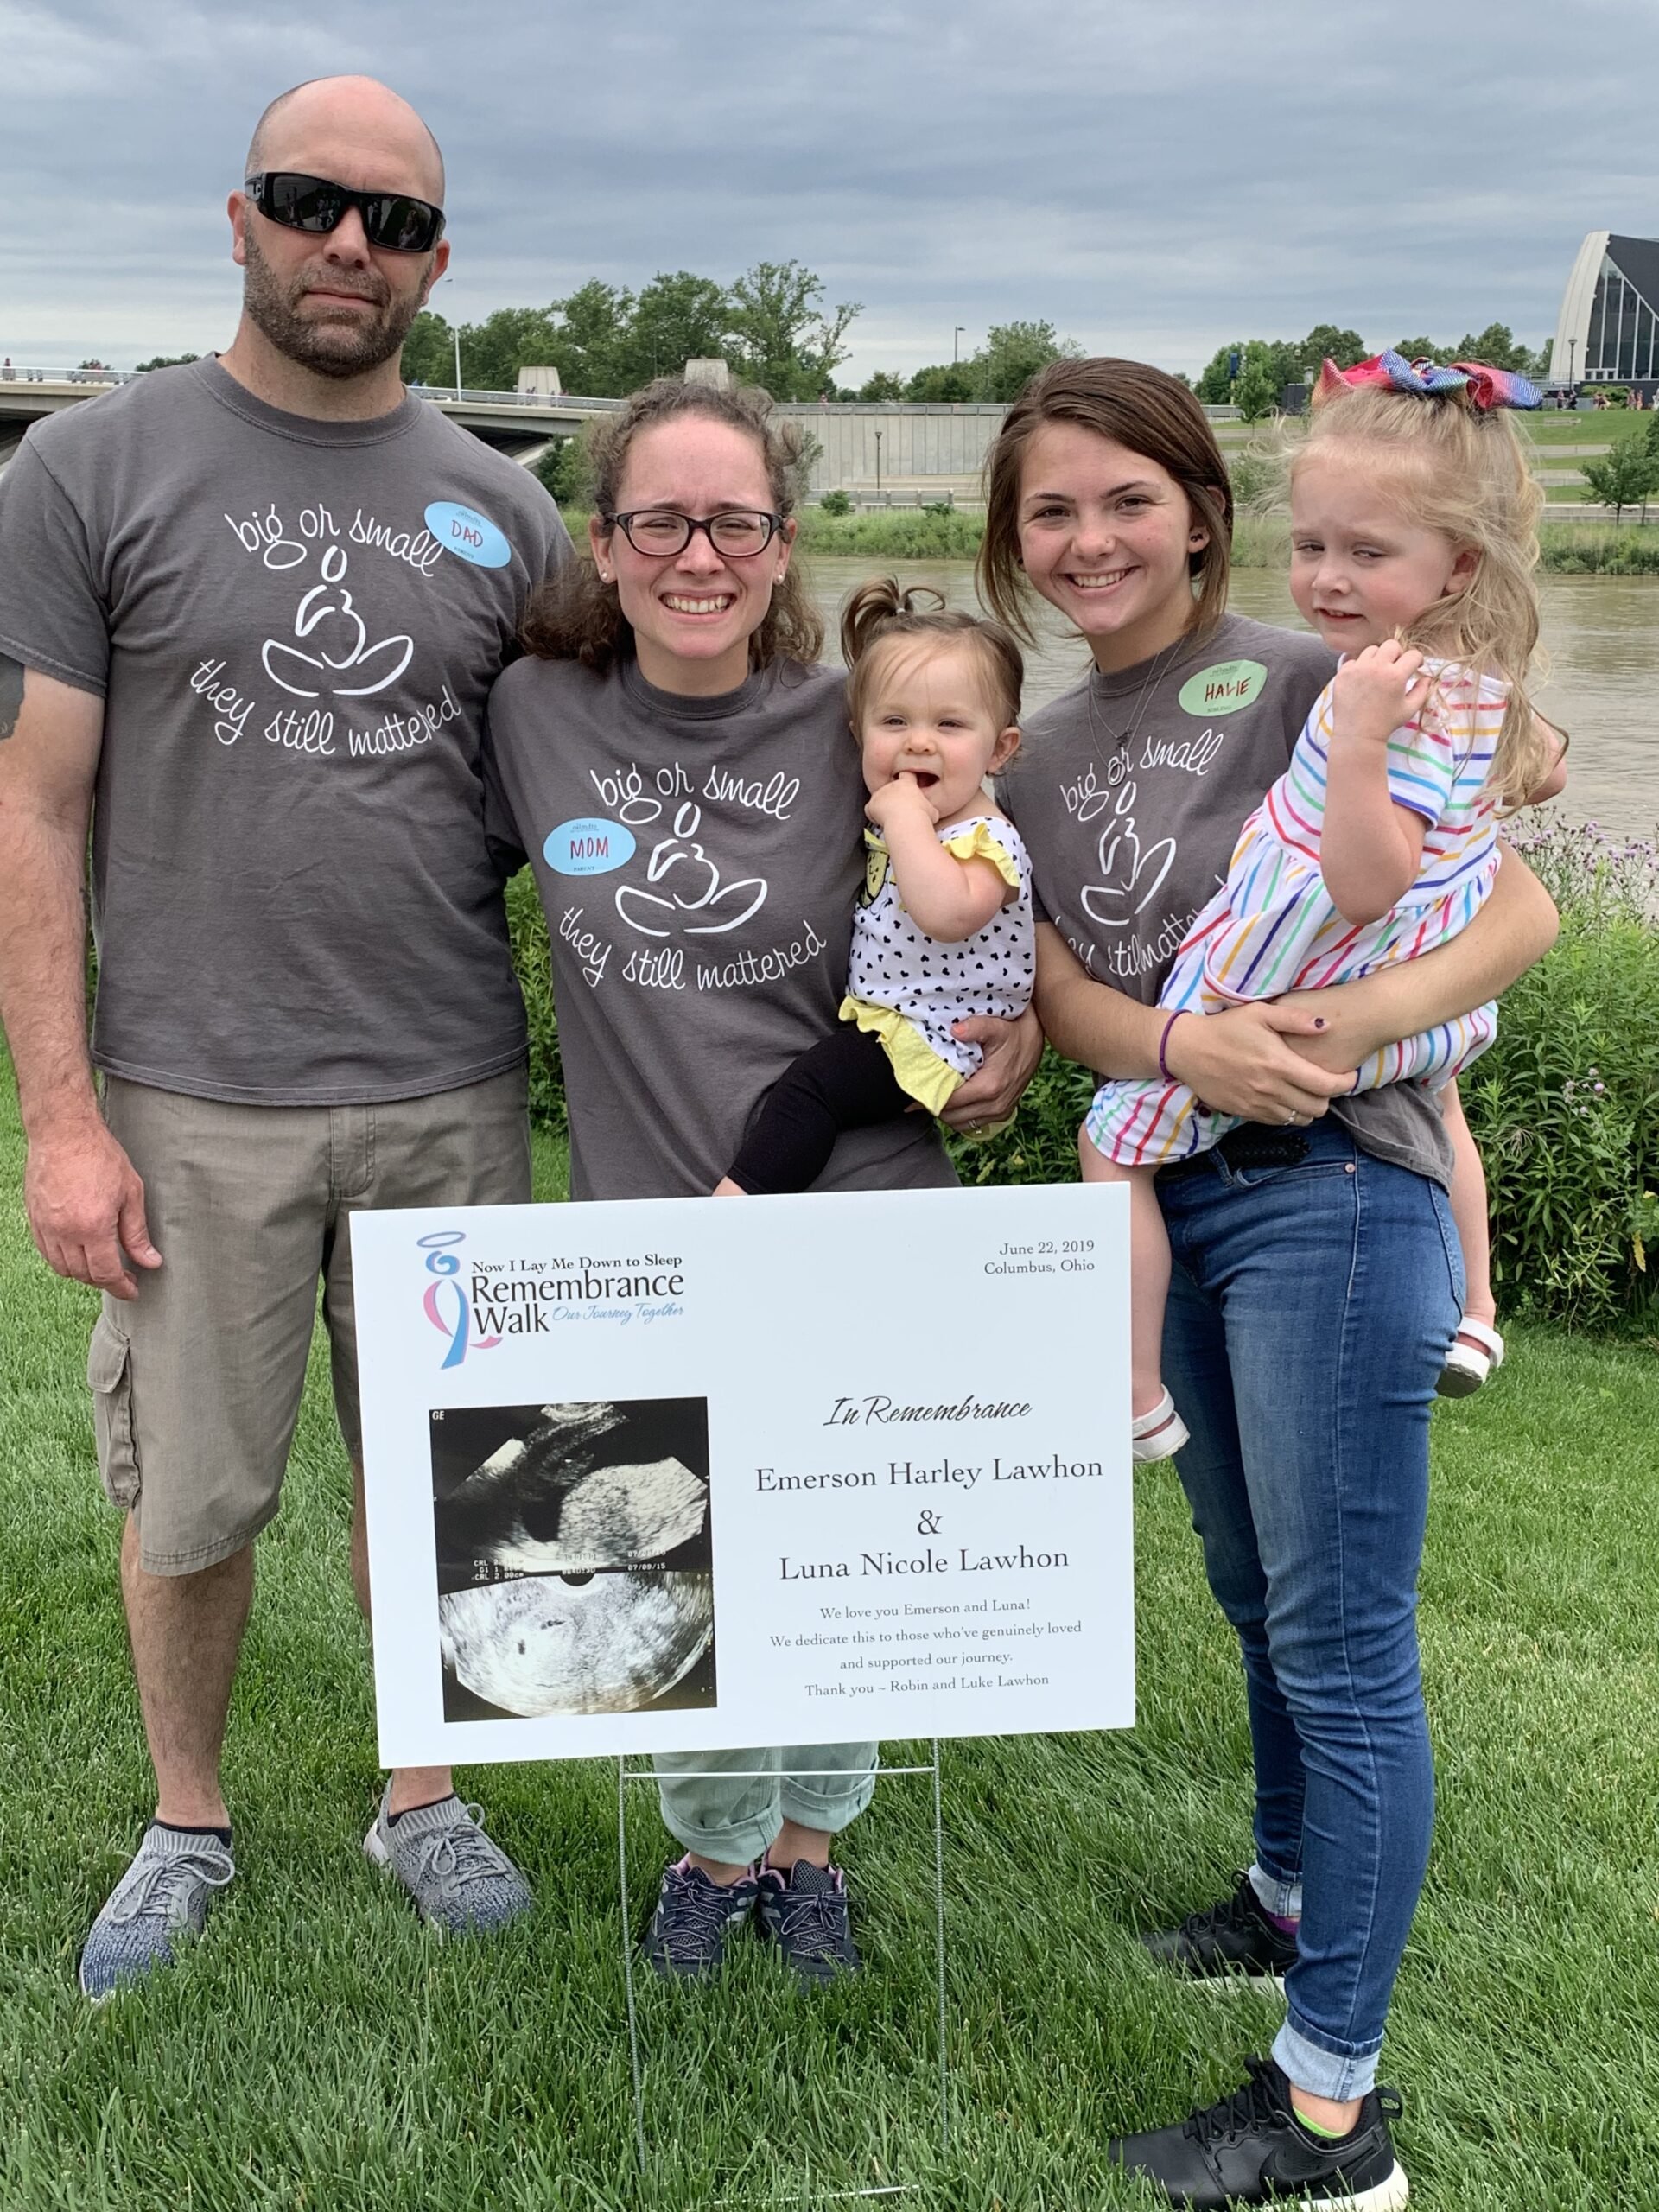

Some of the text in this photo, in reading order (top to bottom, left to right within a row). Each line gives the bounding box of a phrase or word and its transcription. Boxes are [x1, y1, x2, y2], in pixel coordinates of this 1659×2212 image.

[224, 503, 442, 576] big or small
[452, 520, 483, 548] DAD
[190, 659, 461, 757] they still mattered
[1060, 728, 1224, 822] big or small
[590, 762, 800, 824] big or small
[570, 836, 608, 860] MOM
[559, 907, 826, 991] they still mattered
[1000, 1239, 1095, 1255] June 22, 2019
[472, 1253, 683, 1274] Now I Lay Me Down to Sleep
[984, 1258, 1095, 1274] Columbus, Ohio
[472, 1269, 684, 1304] Remembrance
[474, 1303, 550, 1335] Walk
[552, 1302, 684, 1325] Our Journey Together
[432, 1410, 445, 1421] GE
[823, 1395, 1033, 1427] In Remembrance
[755, 1454, 1104, 1491] Emerson Harley Lawhon
[917, 1510, 943, 1535] &
[627, 1562, 666, 1571] 07/09/15
[779, 1545, 1070, 1580] Luna Nicole Lawhon
[820, 1598, 1031, 1620] We love you Emerson and Luna!
[769, 1620, 1082, 1647] We dedicate this to those who've genuinely loved
[840, 1651, 1014, 1670] and supported our journey.
[804, 1682, 846, 1697] Thank
[850, 1685, 874, 1698] you
[890, 1680, 929, 1693] Robin
[932, 1677, 956, 1690] and
[961, 1675, 994, 1688] Luke
[998, 1673, 1049, 1687] Lawhon
